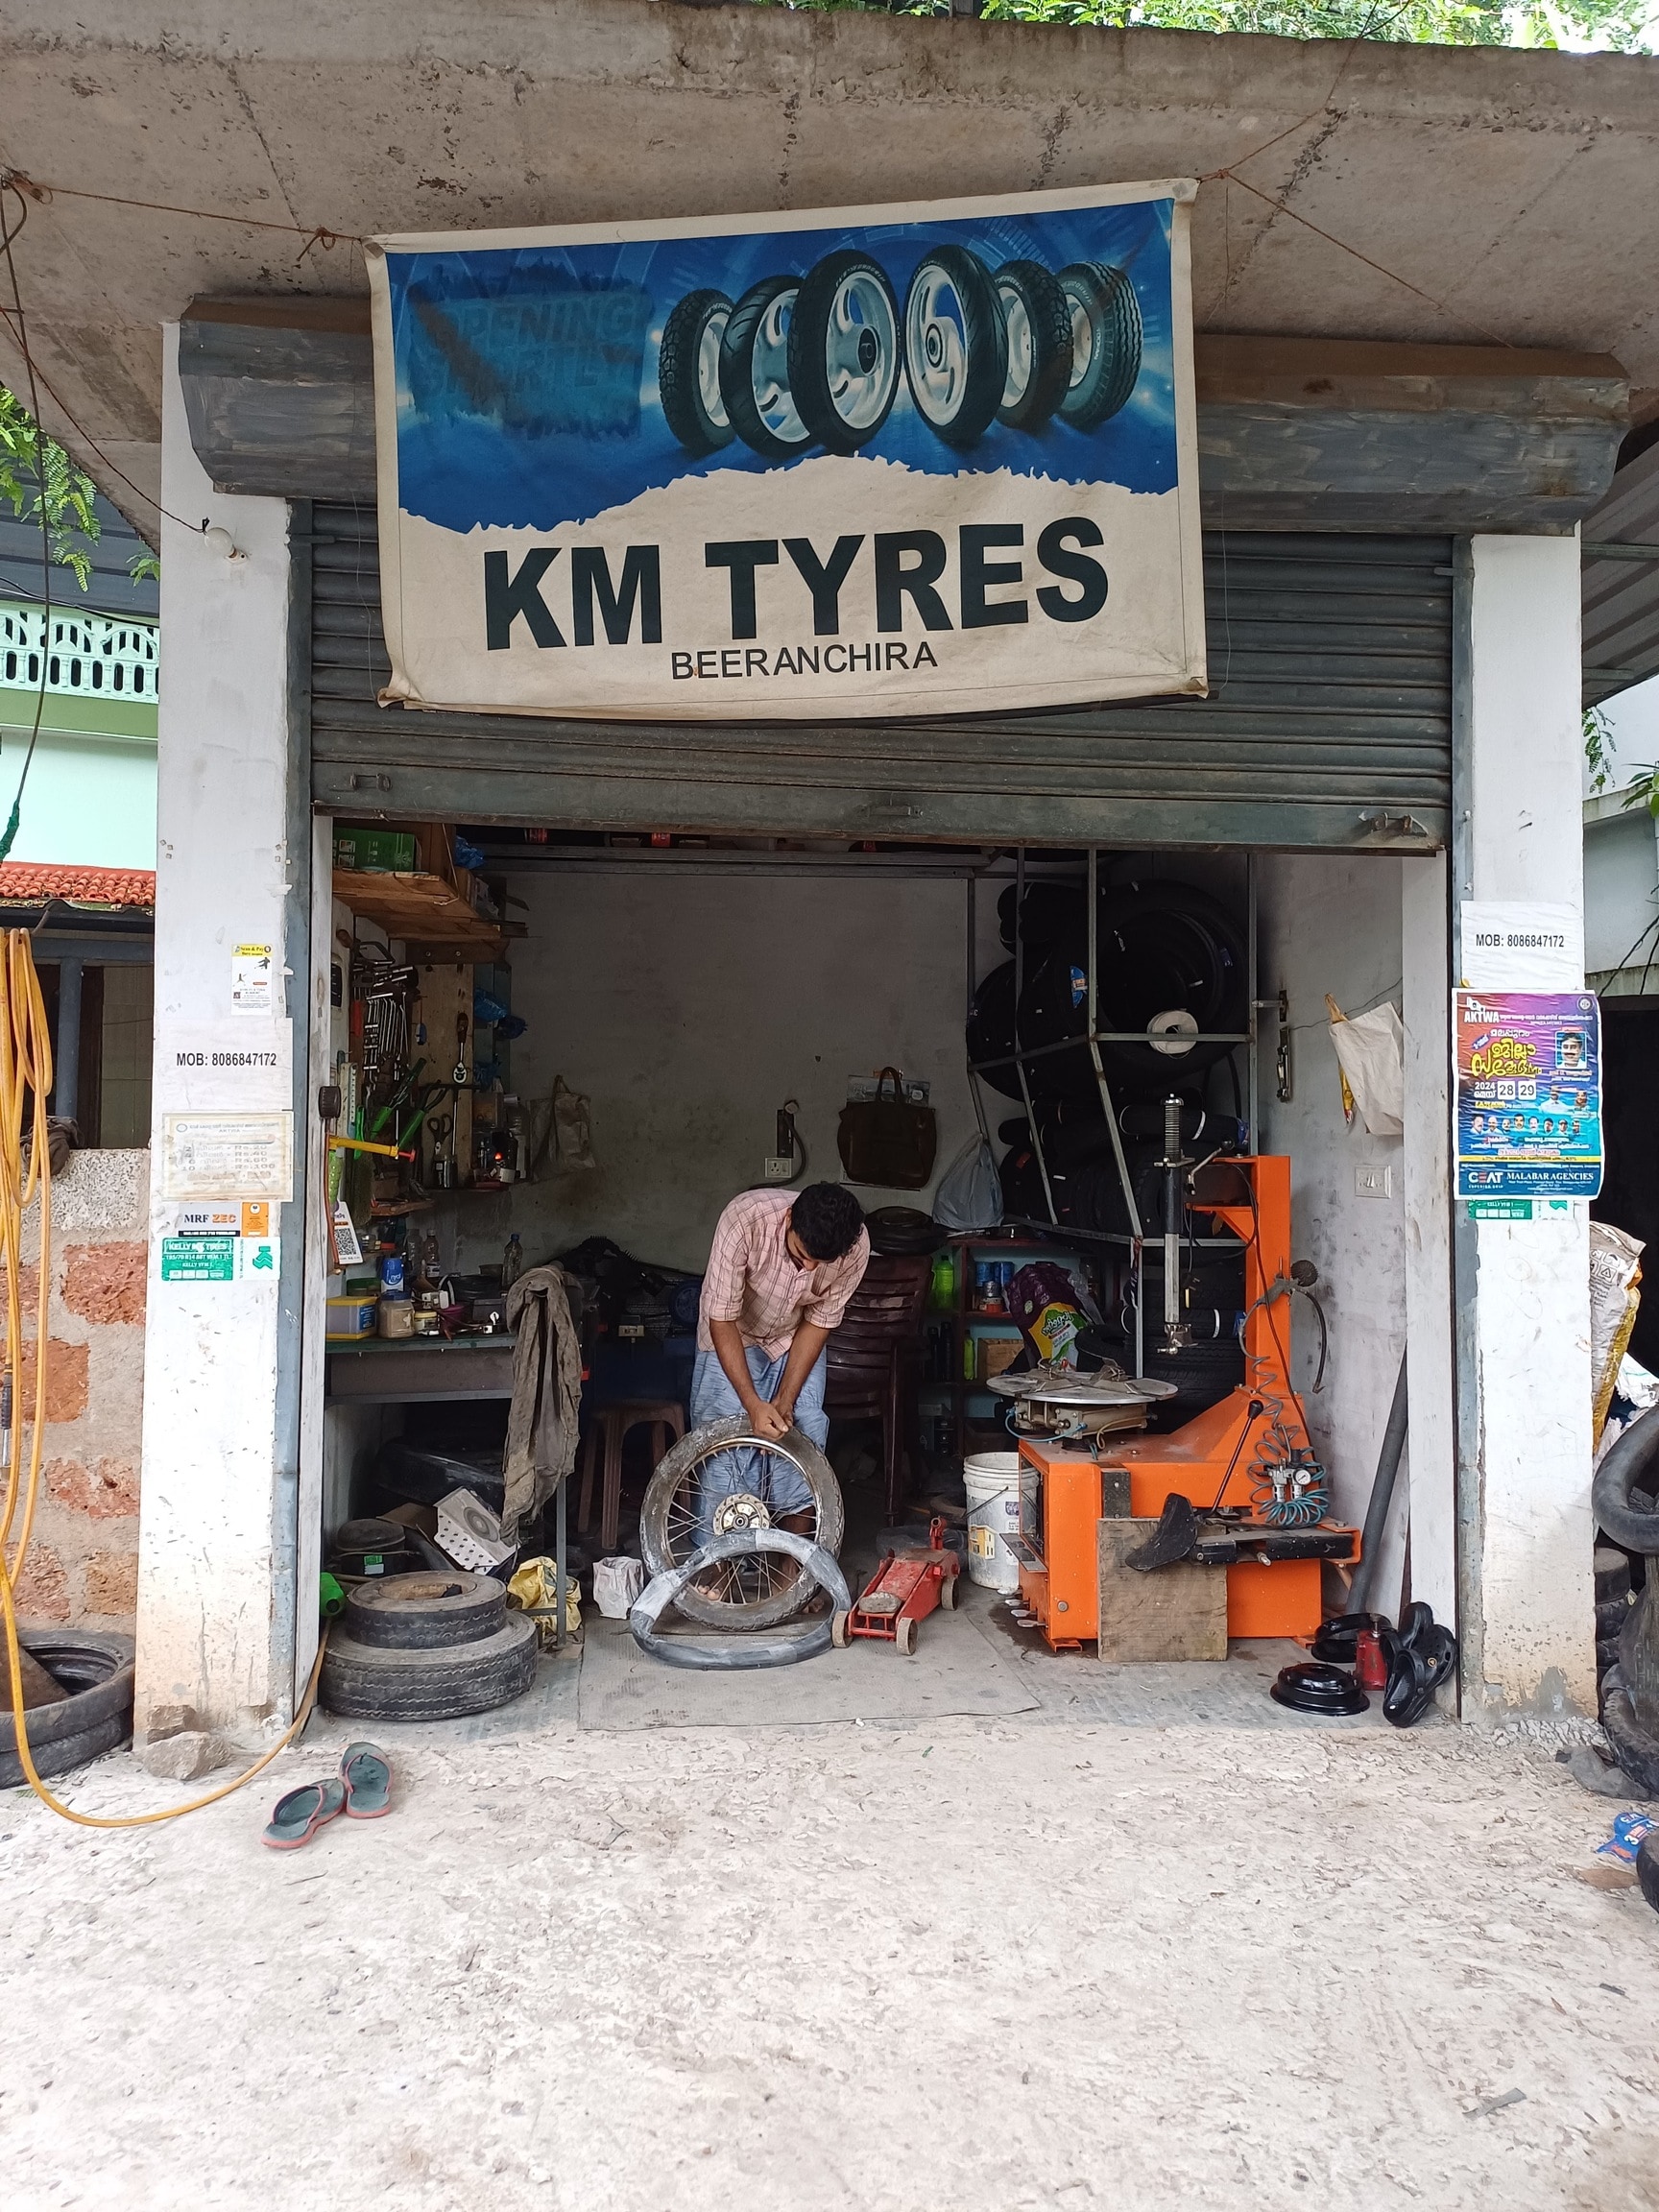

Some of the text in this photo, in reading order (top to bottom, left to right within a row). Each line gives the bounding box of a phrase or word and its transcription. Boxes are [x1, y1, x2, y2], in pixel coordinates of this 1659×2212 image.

[484, 517, 1109, 651] KM TYRES
[671, 641, 939, 681] BEERANCHIRA
[1476, 934, 1565, 948] MOB: 8086847172
[1464, 1012, 1500, 1023] AKTWA
[1491, 1038, 1537, 1061] ജില്ലാ
[177, 1052, 276, 1067] MOB: 8086847172
[1475, 1081, 1496, 1091] 2024
[1499, 1085, 1535, 1096] 28 29
[1468, 1171, 1503, 1184] CEAT
[1506, 1172, 1549, 1181] MALABAR
[1550, 1172, 1595, 1181] AGENCIES
[183, 1214, 237, 1224] MRF ZEC
